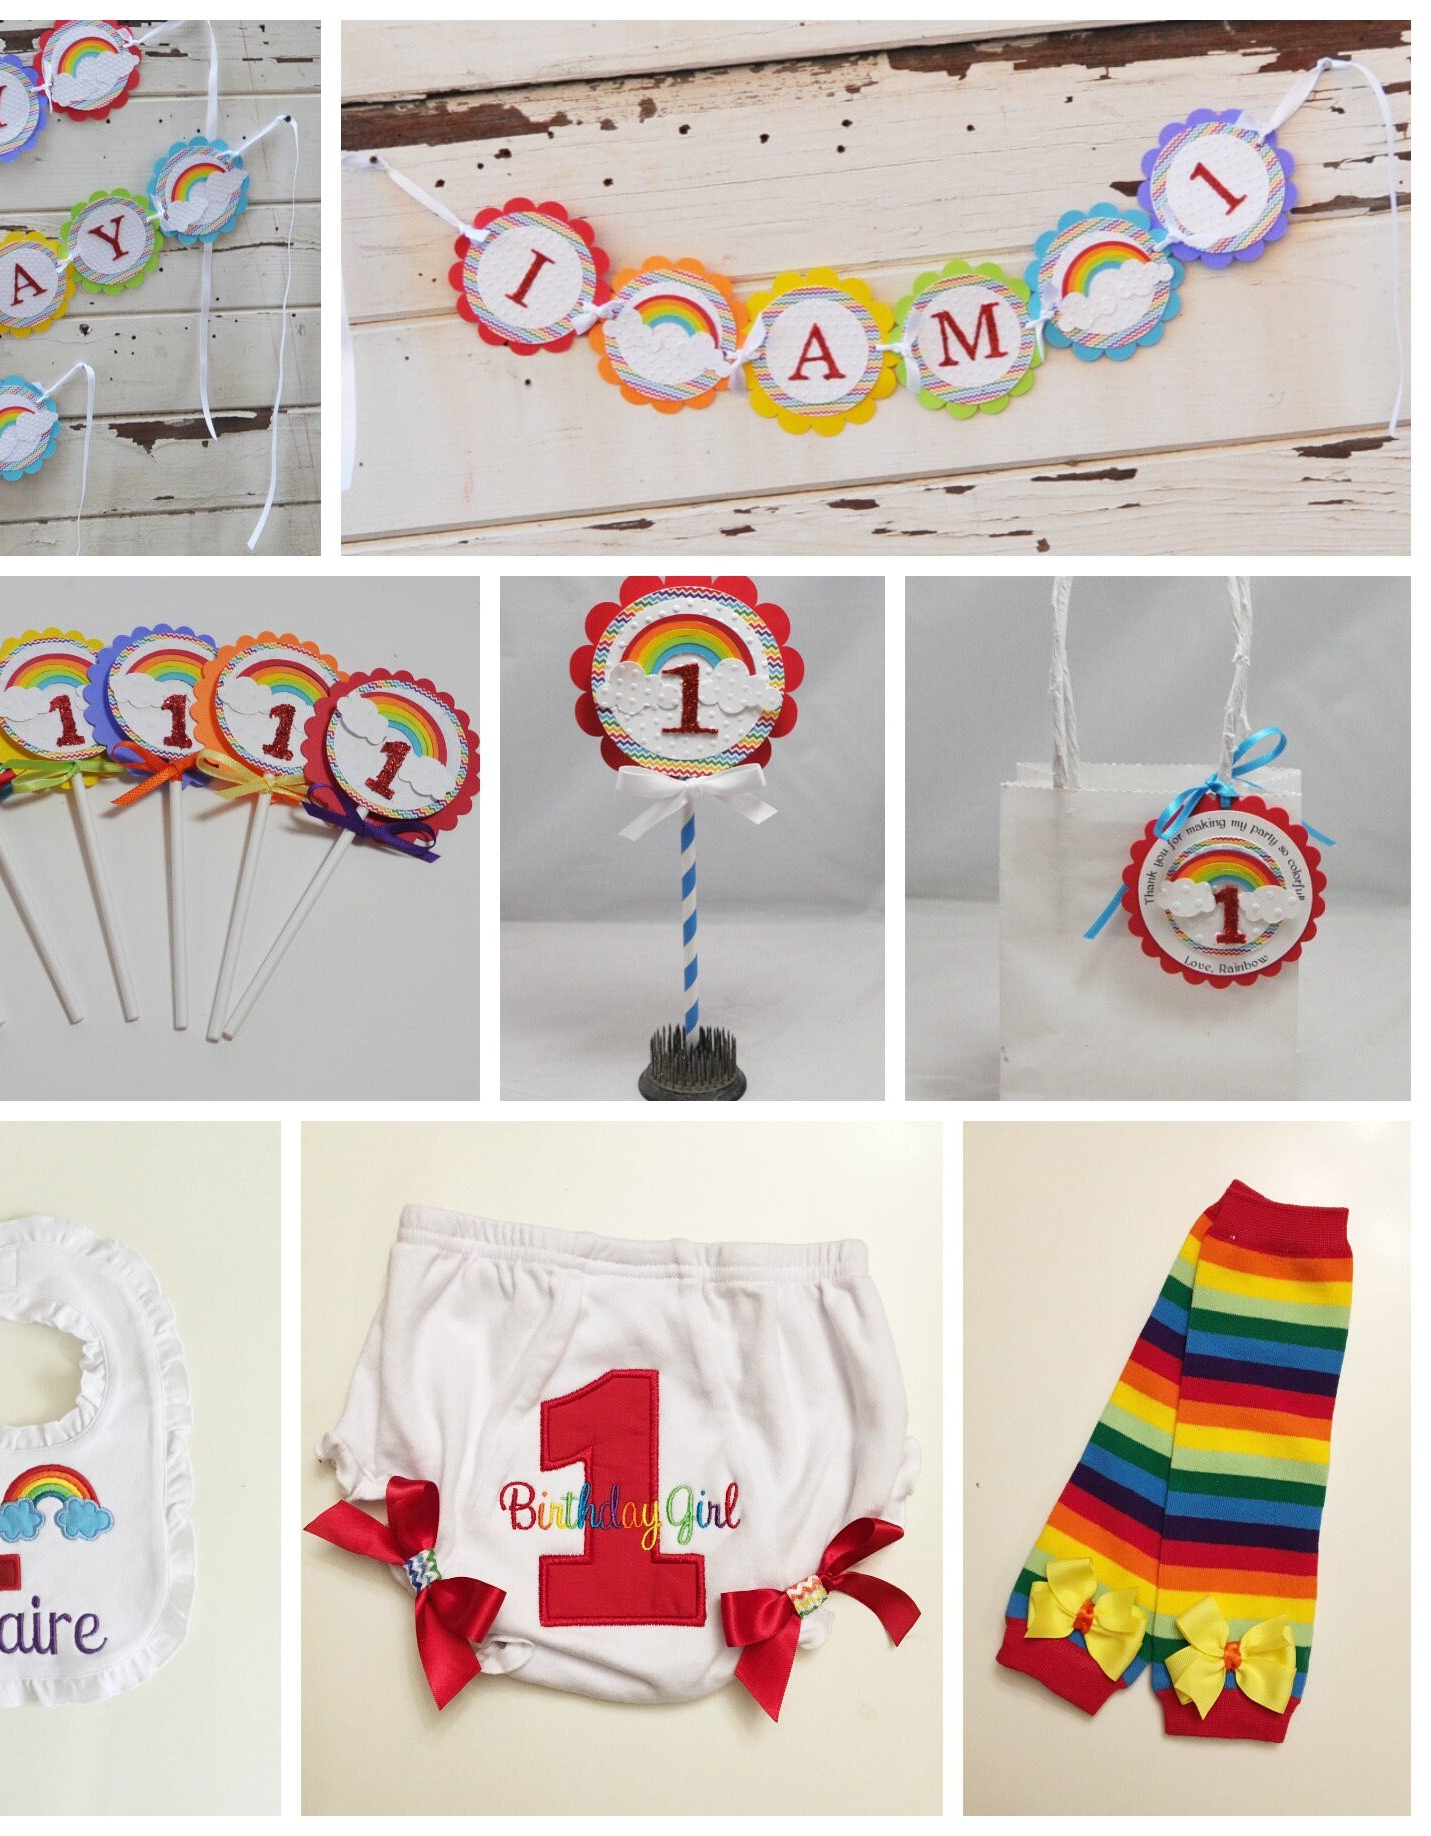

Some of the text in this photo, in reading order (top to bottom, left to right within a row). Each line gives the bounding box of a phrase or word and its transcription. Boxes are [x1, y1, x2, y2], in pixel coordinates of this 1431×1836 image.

[505, 161, 1249, 382] I AM 1
[48, 694, 86, 748] 1
[161, 694, 193, 749] 1
[661, 663, 719, 734] 1
[260, 702, 297, 761] 1
[364, 740, 412, 801] 1
[1144, 871, 1157, 905] Thank
[1153, 848, 1169, 868] you
[1167, 833, 1182, 850] for
[1186, 819, 1226, 835] making
[1230, 819, 1247, 832] my
[1250, 825, 1278, 846] party
[1278, 845, 1289, 856] so
[1213, 884, 1247, 944] 1
[1219, 955, 1268, 973] Rainbow
[499, 1481, 741, 1551] Birthday Girl
[539, 1369, 707, 1628] 1
